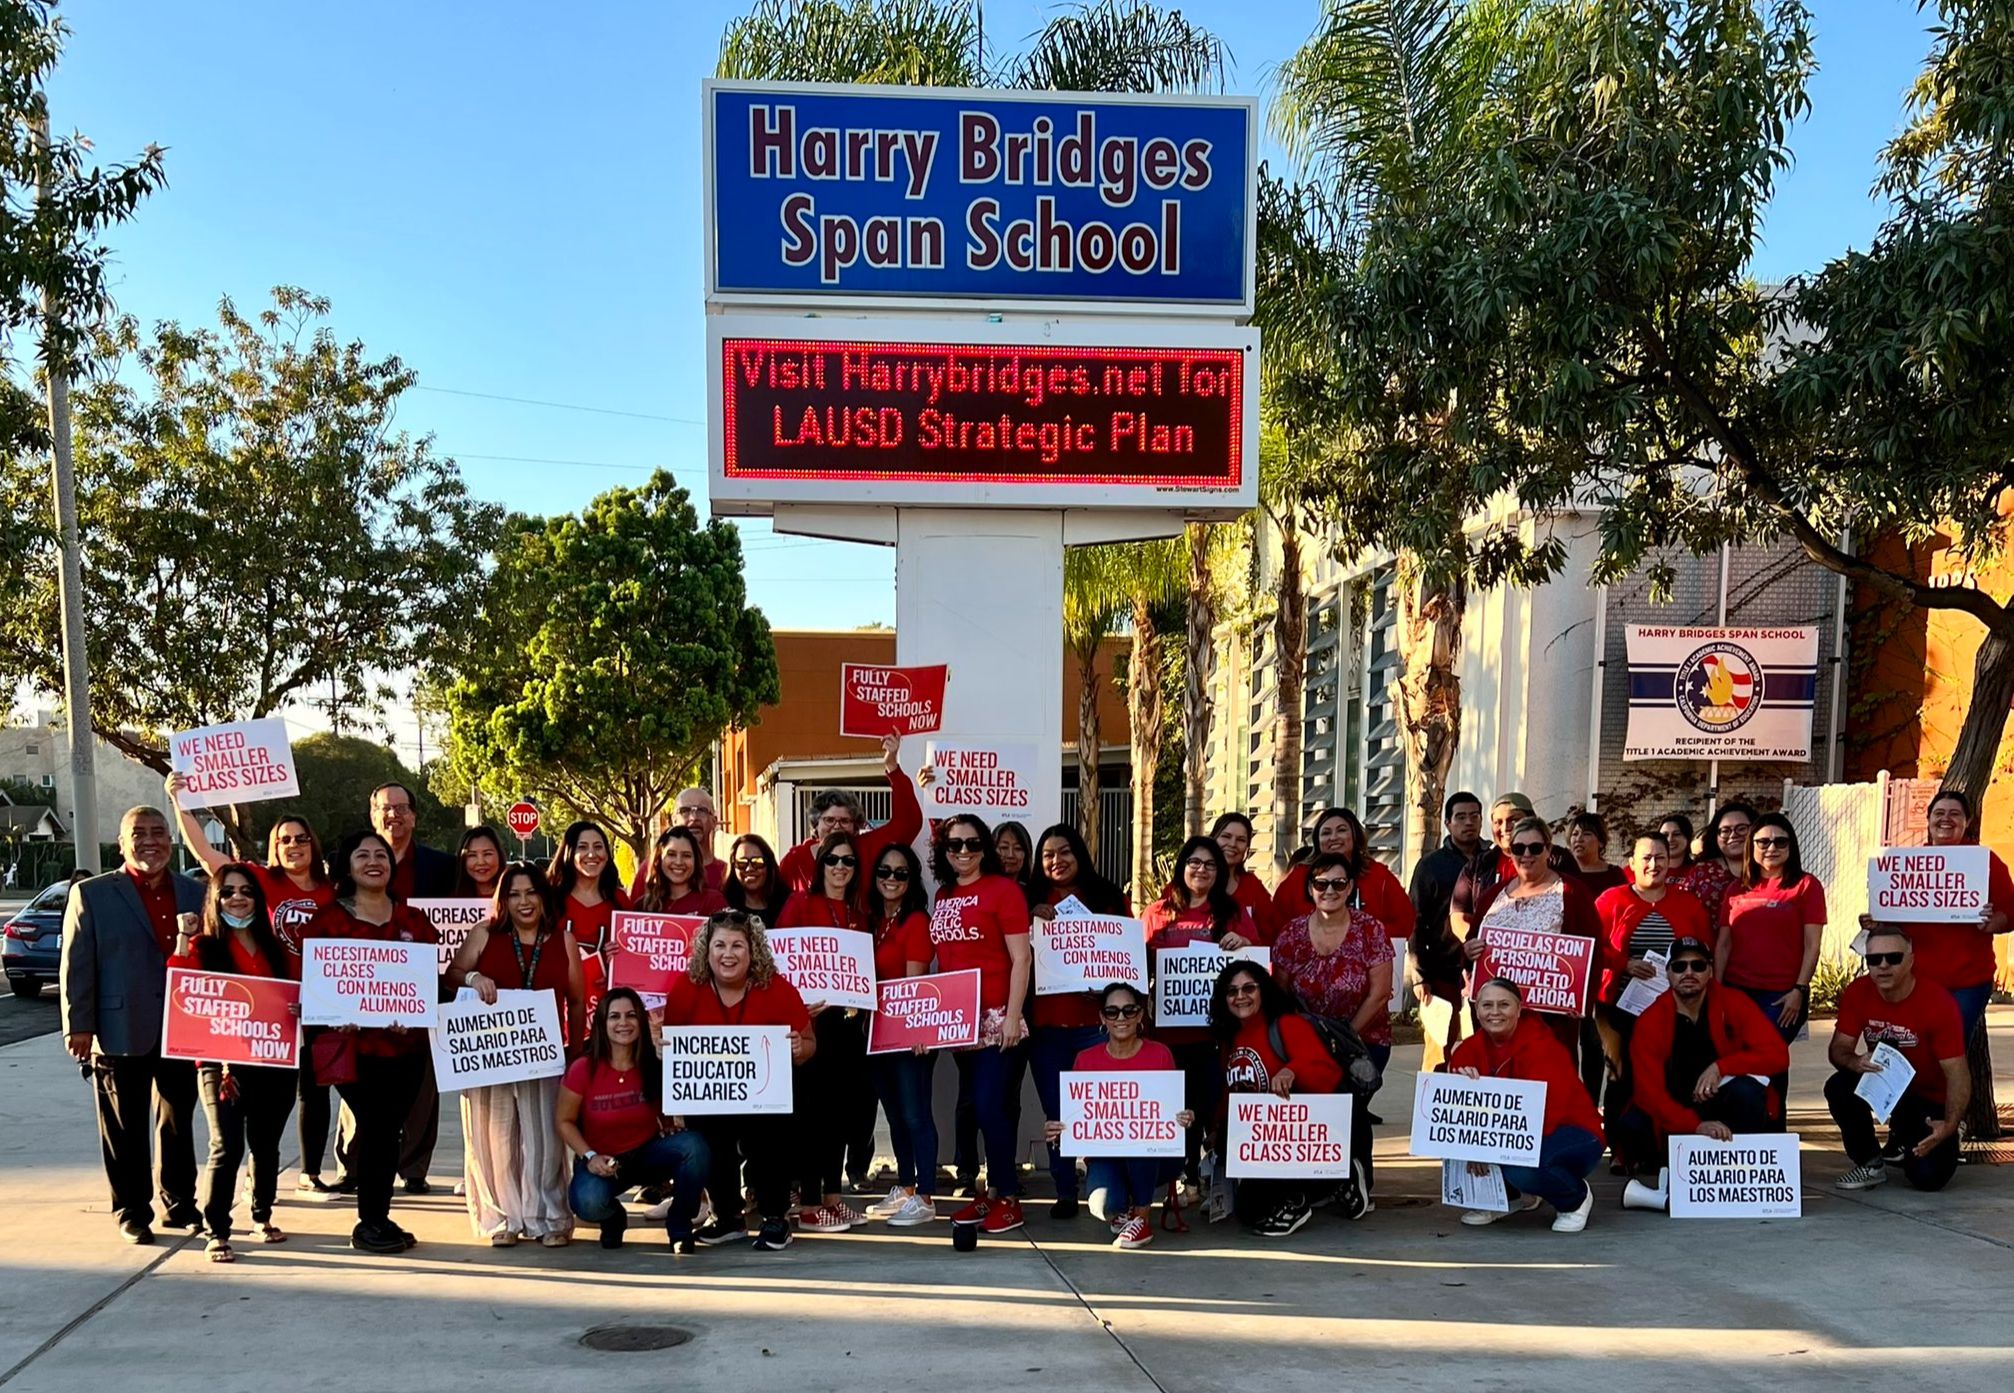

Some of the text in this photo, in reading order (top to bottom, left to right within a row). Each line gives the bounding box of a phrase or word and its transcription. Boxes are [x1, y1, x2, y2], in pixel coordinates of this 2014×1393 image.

[749, 104, 1213, 208] Harry Bridges
[780, 193, 1181, 284] Span School
[738, 350, 827, 391] Visit
[773, 405, 1194, 463] LAUSD Strategic Plan
[1156, 485, 1239, 494] www.StewartSigns.com
[1638, 628, 1806, 639] HARRY BRIDGES SPAN SCHOOL
[853, 669, 890, 686] FULLY
[856, 686, 909, 702] STAFFED
[878, 699, 932, 718] SCHOOLS
[908, 713, 938, 731] NOW
[178, 731, 245, 757] WE NEED
[1675, 737, 1756, 746] RECIPIENT OF THE
[194, 747, 270, 773] SMALLER
[934, 750, 998, 769] WE NEED
[1625, 747, 1649, 755] TITLE
[1657, 747, 1706, 756] ACADEMIC
[1707, 748, 1770, 756] ACHIEVEMENT
[1772, 749, 1807, 757] AWARD
[186, 764, 287, 793] CLASS SIZES
[946, 769, 1015, 788] SMALLER
[935, 786, 1028, 807] CLASS SIZES
[510, 812, 537, 824] STOP
[1877, 855, 1945, 872] WE NEED
[1890, 873, 1965, 890] SMALLER
[1879, 890, 1980, 908] CLASS SIZES
[931, 908, 960, 920] EEDS
[623, 918, 664, 935] FULLY
[929, 917, 961, 932] UBLIC
[1042, 920, 1123, 936] NECESITAMOS
[772, 936, 839, 954] WE NEED
[930, 927, 985, 944] CHOOLS.
[1051, 935, 1096, 951] CLASES
[1485, 930, 1584, 957] ESCUELAS CON
[313, 946, 408, 963] NECESITAMOS
[626, 936, 685, 955] STAFFED
[649, 955, 690, 972] SCHO
[787, 954, 857, 974] SMALLER
[1063, 950, 1131, 966] CON MENOS
[1491, 948, 1560, 972] PERSONAL
[323, 963, 375, 978] CLASES
[1083, 965, 1139, 980] ALUMNOS
[1497, 966, 1569, 990] COMPLETO
[180, 976, 228, 996] FULLY
[337, 980, 417, 997] CON MENOS
[831, 973, 870, 994] SIZES
[882, 983, 919, 1001] FULLY
[1164, 979, 1215, 996] EDUCA
[360, 997, 426, 1014] ALUMNOS
[885, 997, 937, 1016] STAFFED
[1526, 987, 1576, 1008] AHORA
[183, 996, 250, 1019] STAFFED
[1163, 999, 1209, 1016] SALAR
[210, 1017, 282, 1040] SCHOOLS
[447, 1008, 536, 1035] AUMENTO DE
[905, 1009, 963, 1029] SCHOOLS
[449, 1026, 547, 1055] SALARIO PARA
[937, 1024, 970, 1041] NOW
[250, 1040, 291, 1059] NOW
[672, 1036, 750, 1055] INCREASE
[452, 1044, 558, 1074] LOS MAESTROS
[672, 1061, 756, 1080] EDUCATOR
[672, 1082, 748, 1101] SALARIES
[1069, 1081, 1139, 1100] WE NEED
[1432, 1088, 1523, 1111] AUMENTO DE
[1084, 1101, 1160, 1120] SMALLER
[1238, 1104, 1308, 1122] WE NEED
[1431, 1107, 1528, 1132] SALARIO PARA
[1073, 1121, 1176, 1140] CLASS SIZES
[1251, 1123, 1327, 1142] SMALLER
[1429, 1126, 1534, 1151] LOS MAESTROS
[1240, 1143, 1342, 1162] CLASS SIZES
[1688, 1150, 1777, 1166] AUMENTO DE
[1689, 1168, 1786, 1184] SALARIO PARA
[1689, 1187, 1794, 1203] LOS MAESTROS
